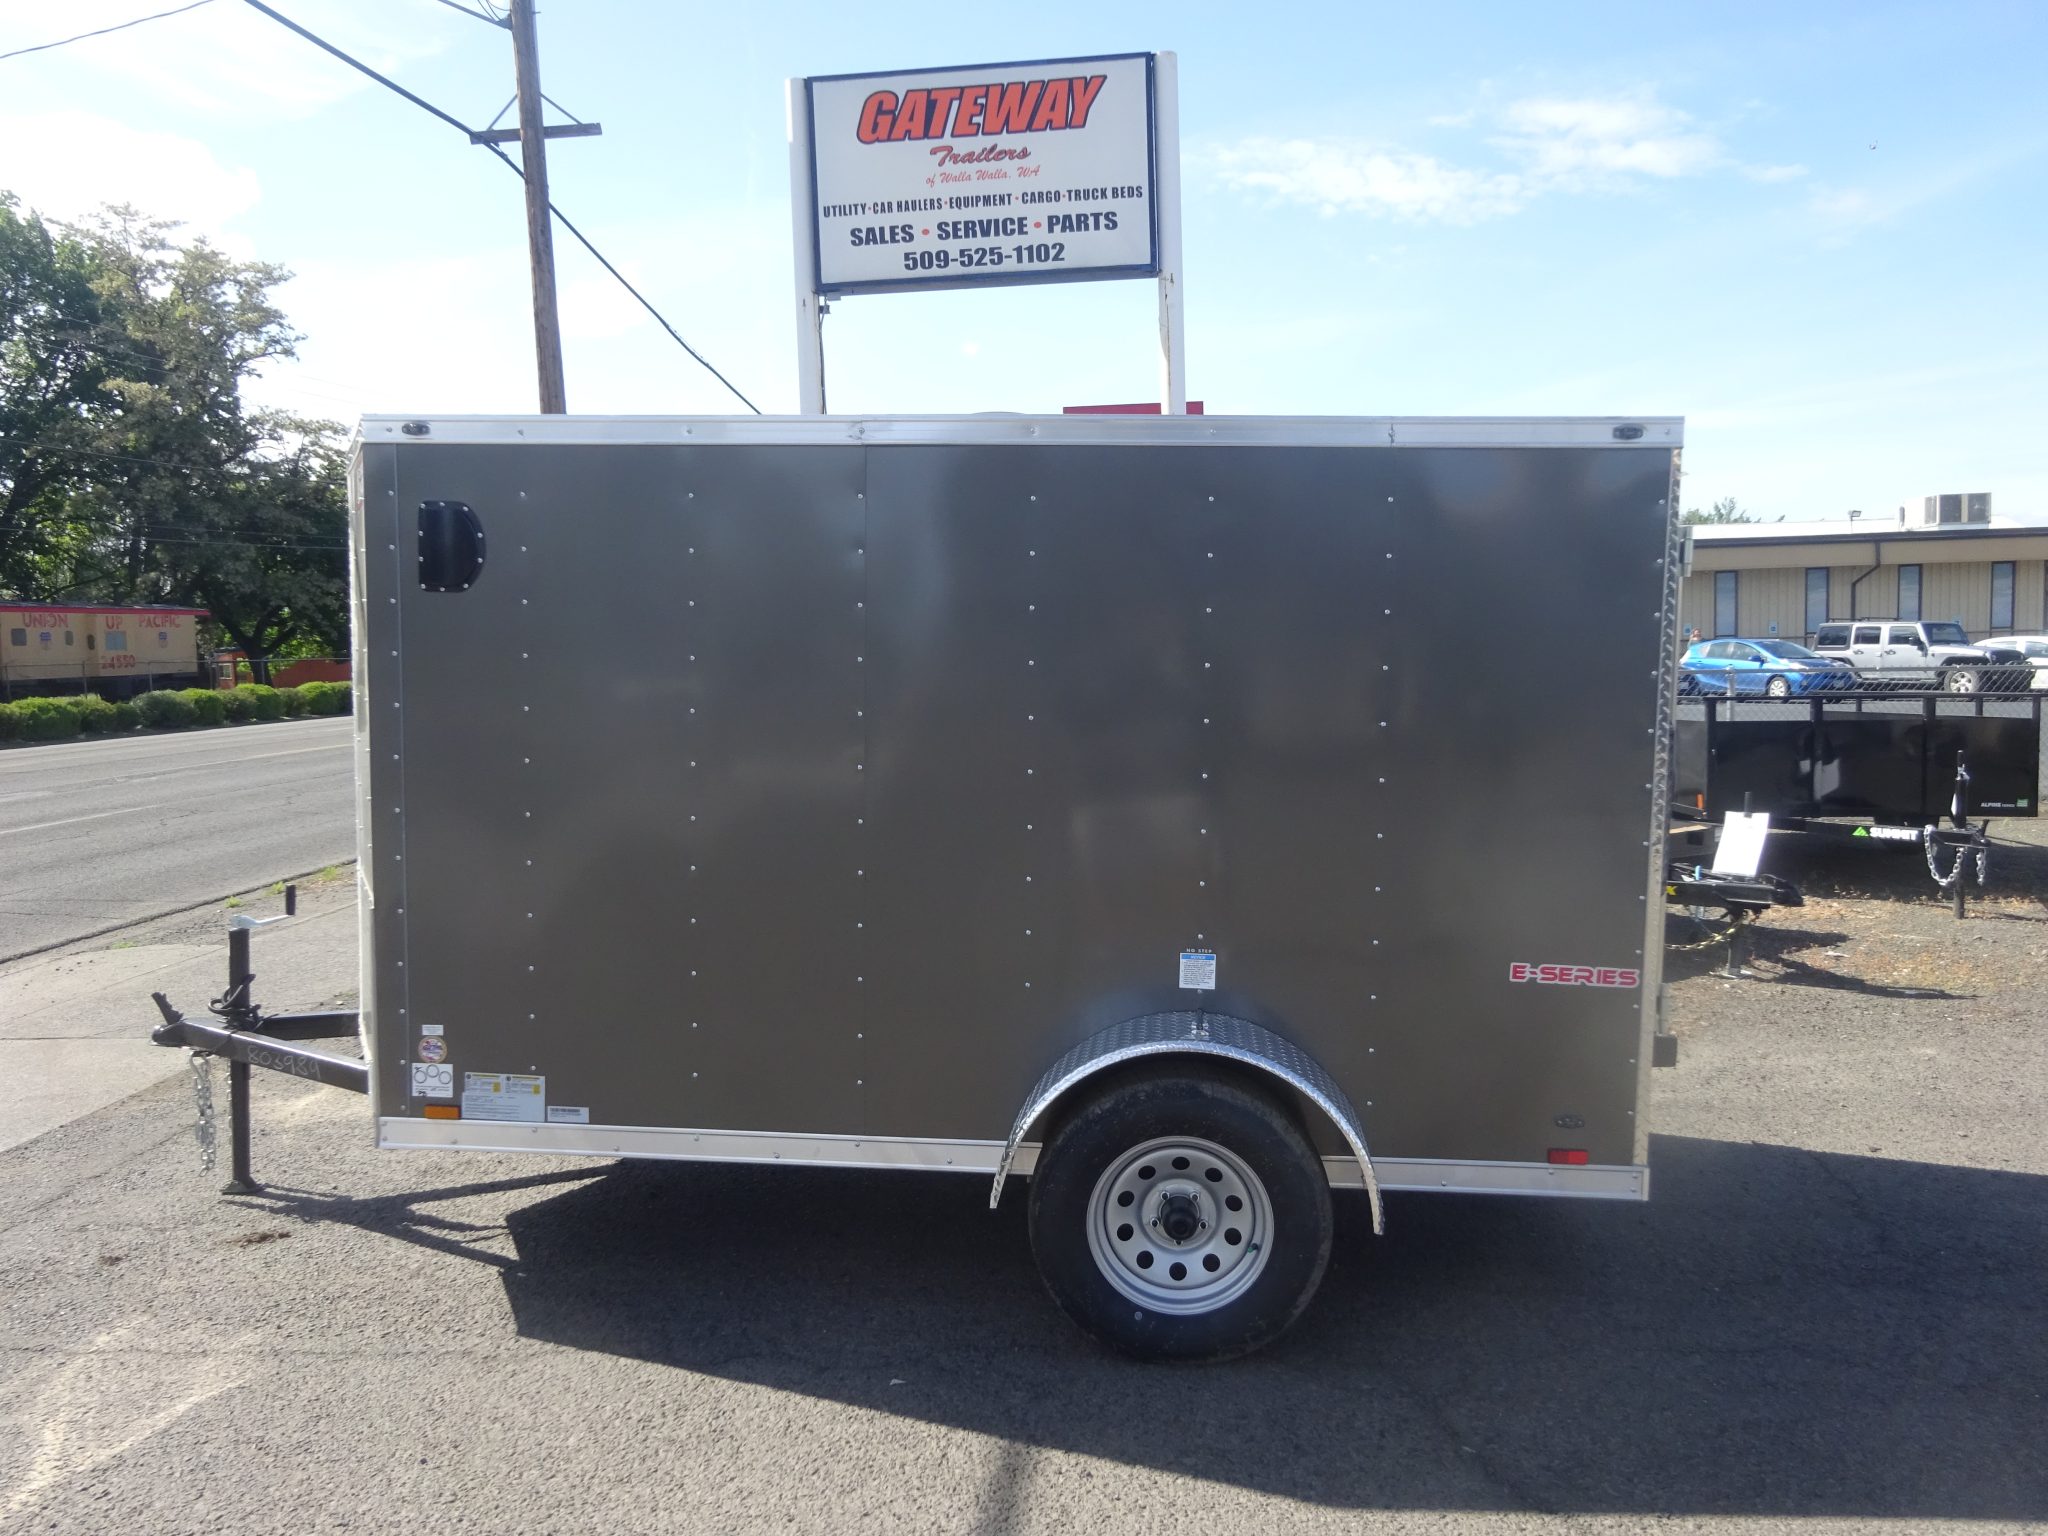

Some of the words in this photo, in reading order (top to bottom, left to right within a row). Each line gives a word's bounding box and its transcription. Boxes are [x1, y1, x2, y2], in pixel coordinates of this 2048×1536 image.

[856, 74, 1107, 145] GATEWAY
[929, 143, 1031, 167] Trailers
[926, 174, 936, 188] of
[940, 171, 972, 183] Walla
[1016, 164, 1041, 178] WA
[823, 203, 867, 218] UTILITY
[873, 201, 893, 214] CAR
[897, 197, 943, 213] HAULERS
[949, 193, 1013, 210] EQUIPMENT
[1021, 190, 1062, 204] CARGO
[1067, 187, 1108, 202] TRUCK
[1111, 186, 1143, 199] BEDS
[850, 223, 915, 247] SALES
[936, 216, 1029, 241] SERVICE
[1047, 211, 1119, 234] PARTS
[903, 242, 1066, 271] 509-525-1102
[23, 613, 69, 628] UNION
[106, 615, 123, 630] UP
[138, 615, 182, 629] PACIFIC
[1510, 962, 1640, 988] E-SERIES
